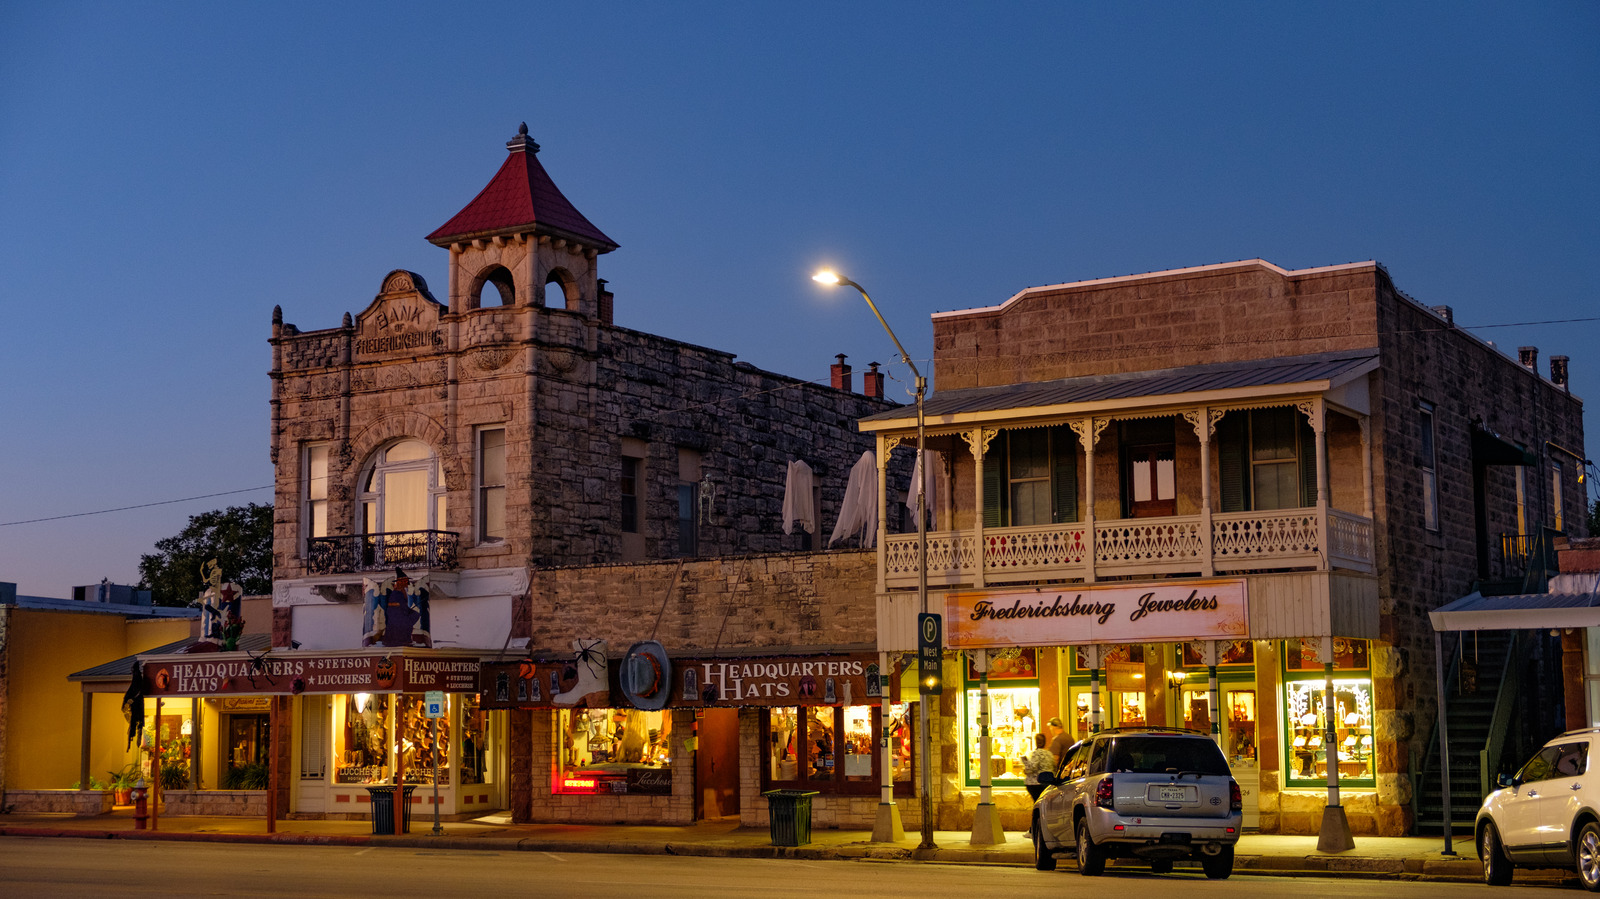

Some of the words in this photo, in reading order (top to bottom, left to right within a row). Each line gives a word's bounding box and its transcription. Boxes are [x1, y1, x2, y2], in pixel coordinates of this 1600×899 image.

[376, 305, 424, 330] BANK
[394, 323, 405, 332] OF
[356, 330, 444, 355] FREDERICKSBURG
[970, 594, 1116, 625] Fredericksburg
[1130, 590, 1218, 622] Jewelers
[926, 621, 934, 638] P
[923, 647, 938, 657] West
[317, 658, 371, 669] STETSON
[404, 659, 480, 674] HEADQUARTERS
[923, 660, 938, 670] Main
[317, 674, 372, 685] LUCCHESE
[409, 671, 436, 684] HATS
[702, 661, 864, 685] HEADQUARTERS
[177, 676, 218, 692] HATS
[718, 678, 790, 700] HATS
